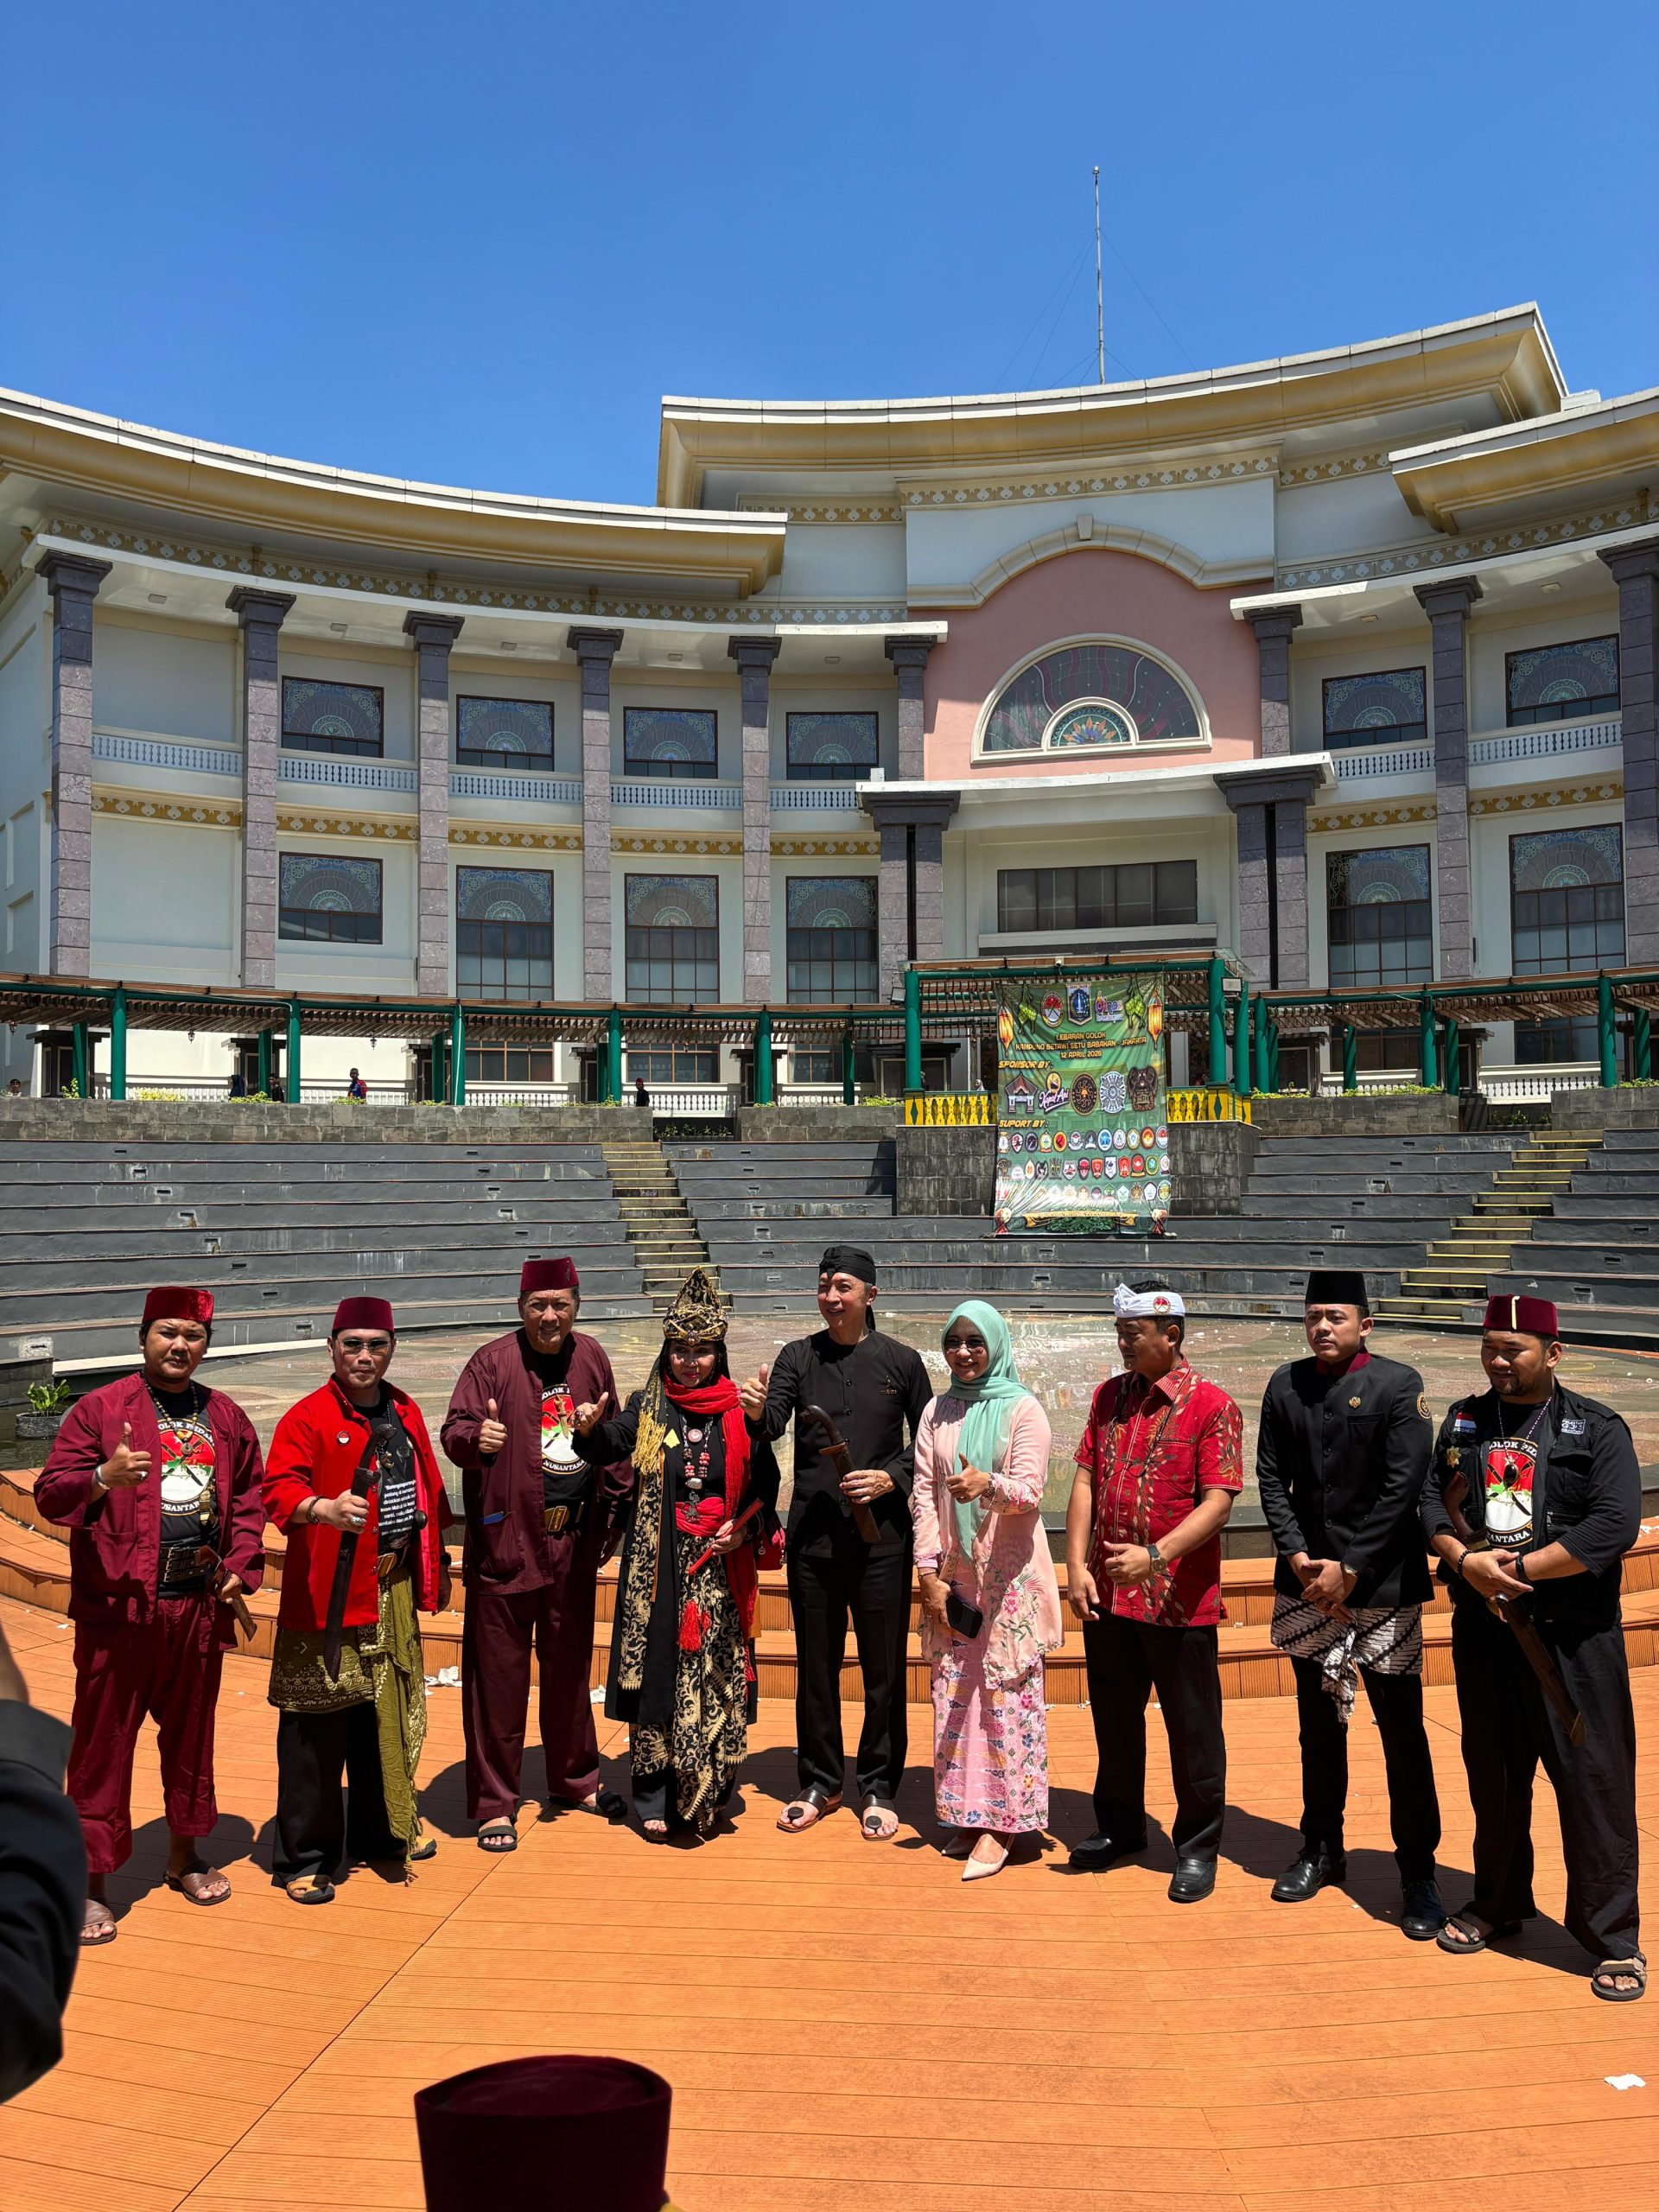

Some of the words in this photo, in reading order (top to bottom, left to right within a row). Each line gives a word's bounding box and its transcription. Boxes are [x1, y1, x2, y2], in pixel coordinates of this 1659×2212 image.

[1015, 1042, 1046, 1051] KAMPUNG
[1070, 1041, 1086, 1050] SETU
[1121, 1037, 1147, 1046] JAKARTA
[542, 1387, 565, 1400] OLOK
[157, 1421, 184, 1430] OLOK
[1489, 1440, 1519, 1450] OLOK
